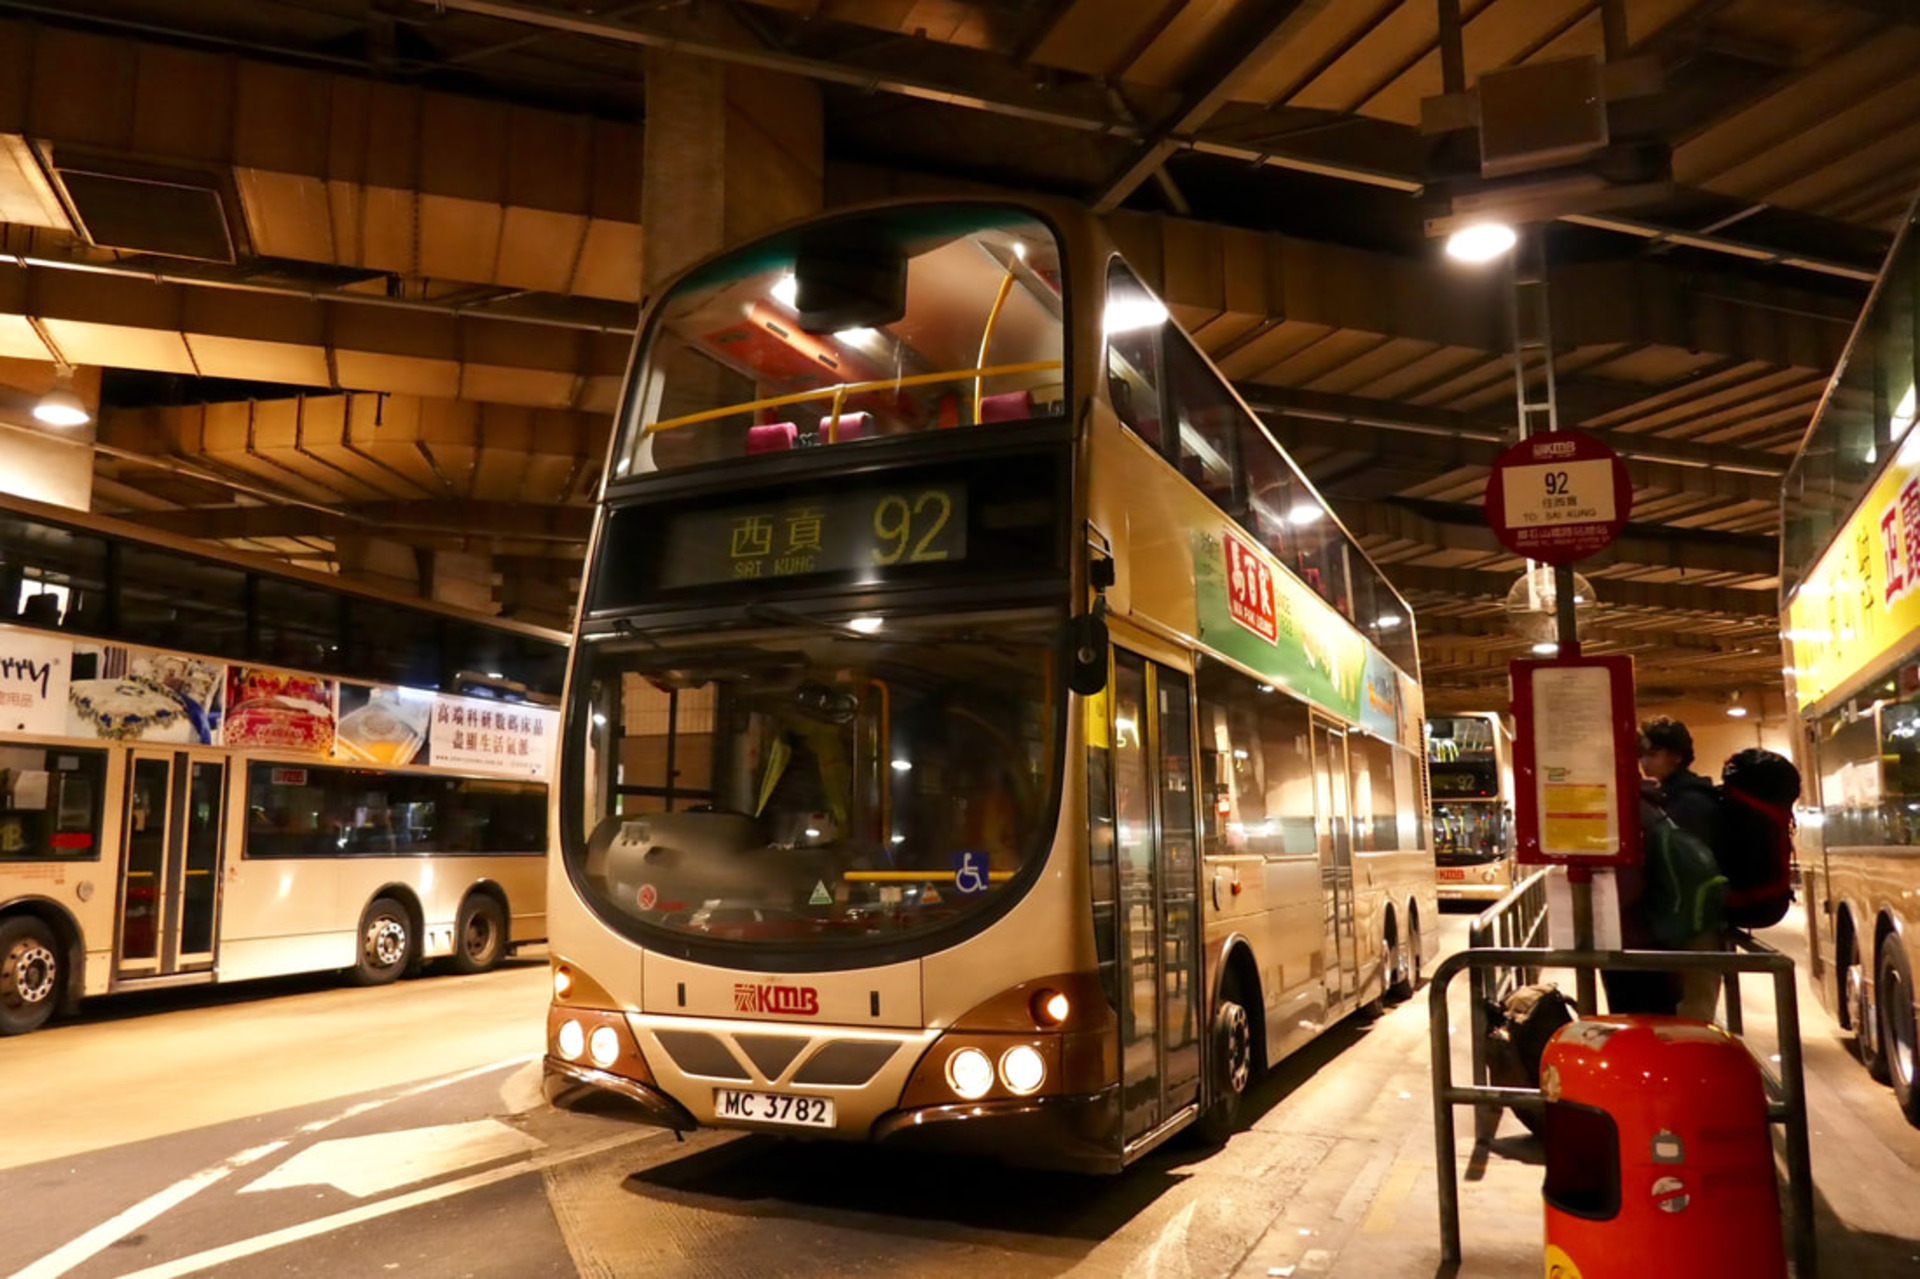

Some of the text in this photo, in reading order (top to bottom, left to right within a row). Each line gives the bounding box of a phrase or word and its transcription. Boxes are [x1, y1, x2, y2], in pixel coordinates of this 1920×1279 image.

[1544, 472, 1569, 495] 92
[872, 490, 951, 566] 92
[1523, 512, 1538, 521] TO
[1567, 508, 1597, 518] KUNG
[731, 508, 825, 557] 西貢
[735, 556, 815, 577] SAI KUNG
[757, 985, 820, 1017] KMB
[725, 1091, 826, 1123] MC 3782
